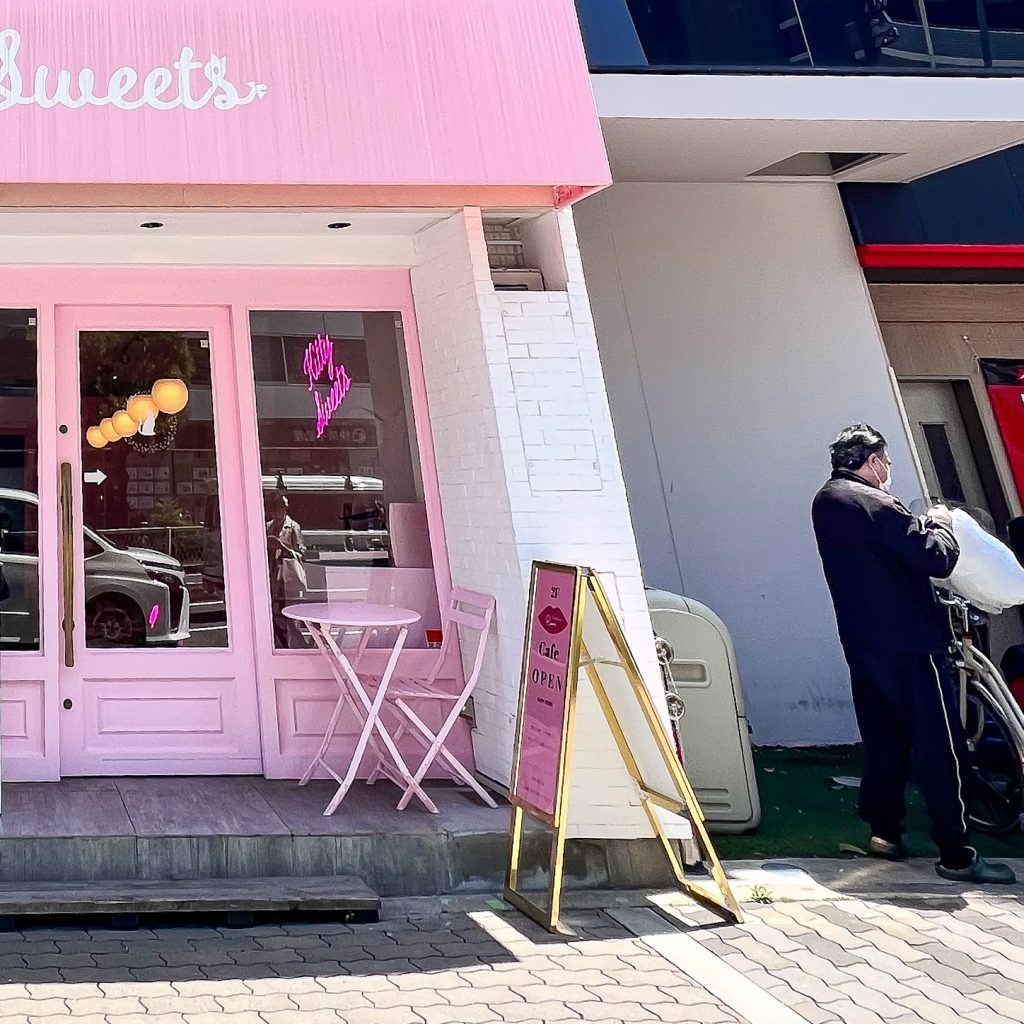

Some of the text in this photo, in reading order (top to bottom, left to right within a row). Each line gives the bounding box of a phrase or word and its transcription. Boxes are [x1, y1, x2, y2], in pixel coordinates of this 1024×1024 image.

[550, 586, 560, 598] 2F
[538, 641, 560, 661] Cafe
[532, 668, 562, 692] OPEN
